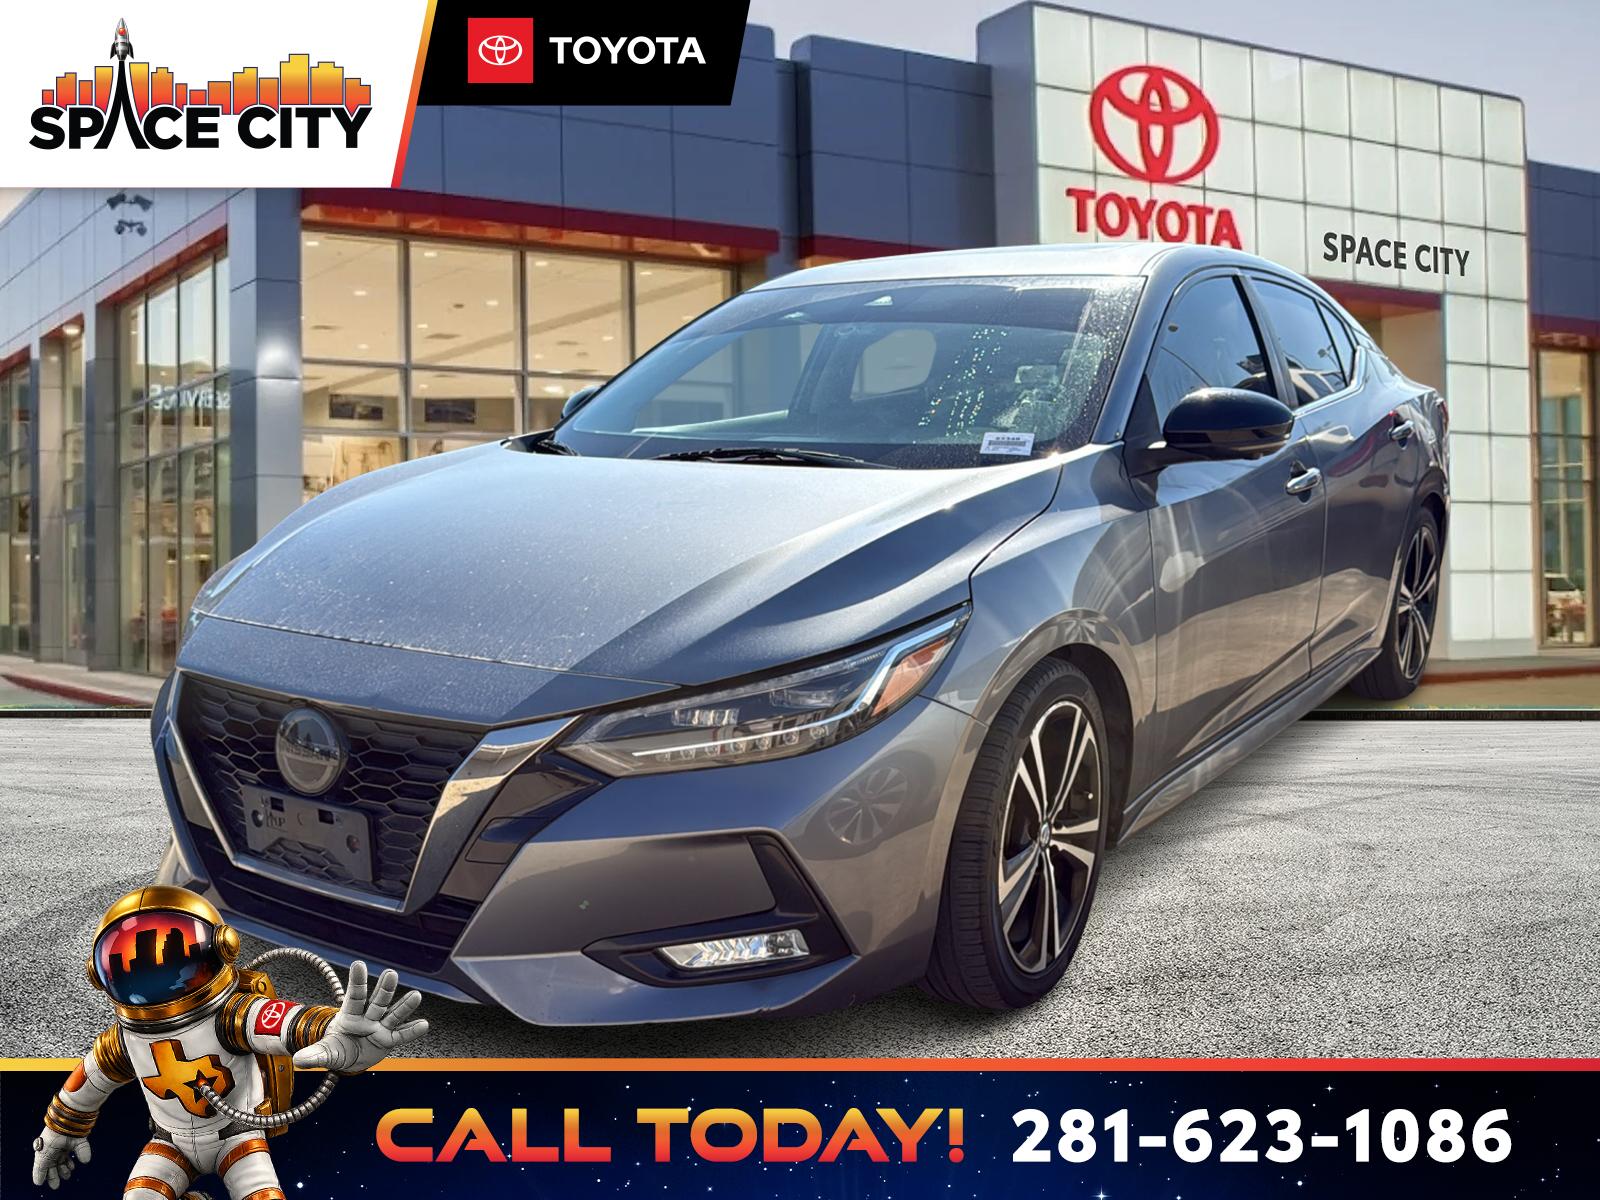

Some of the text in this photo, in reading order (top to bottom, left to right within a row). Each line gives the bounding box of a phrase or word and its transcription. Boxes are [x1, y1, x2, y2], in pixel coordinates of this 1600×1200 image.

[1065, 187, 1242, 250] TOYOTA
[1323, 232, 1471, 277] SPACE CITY
